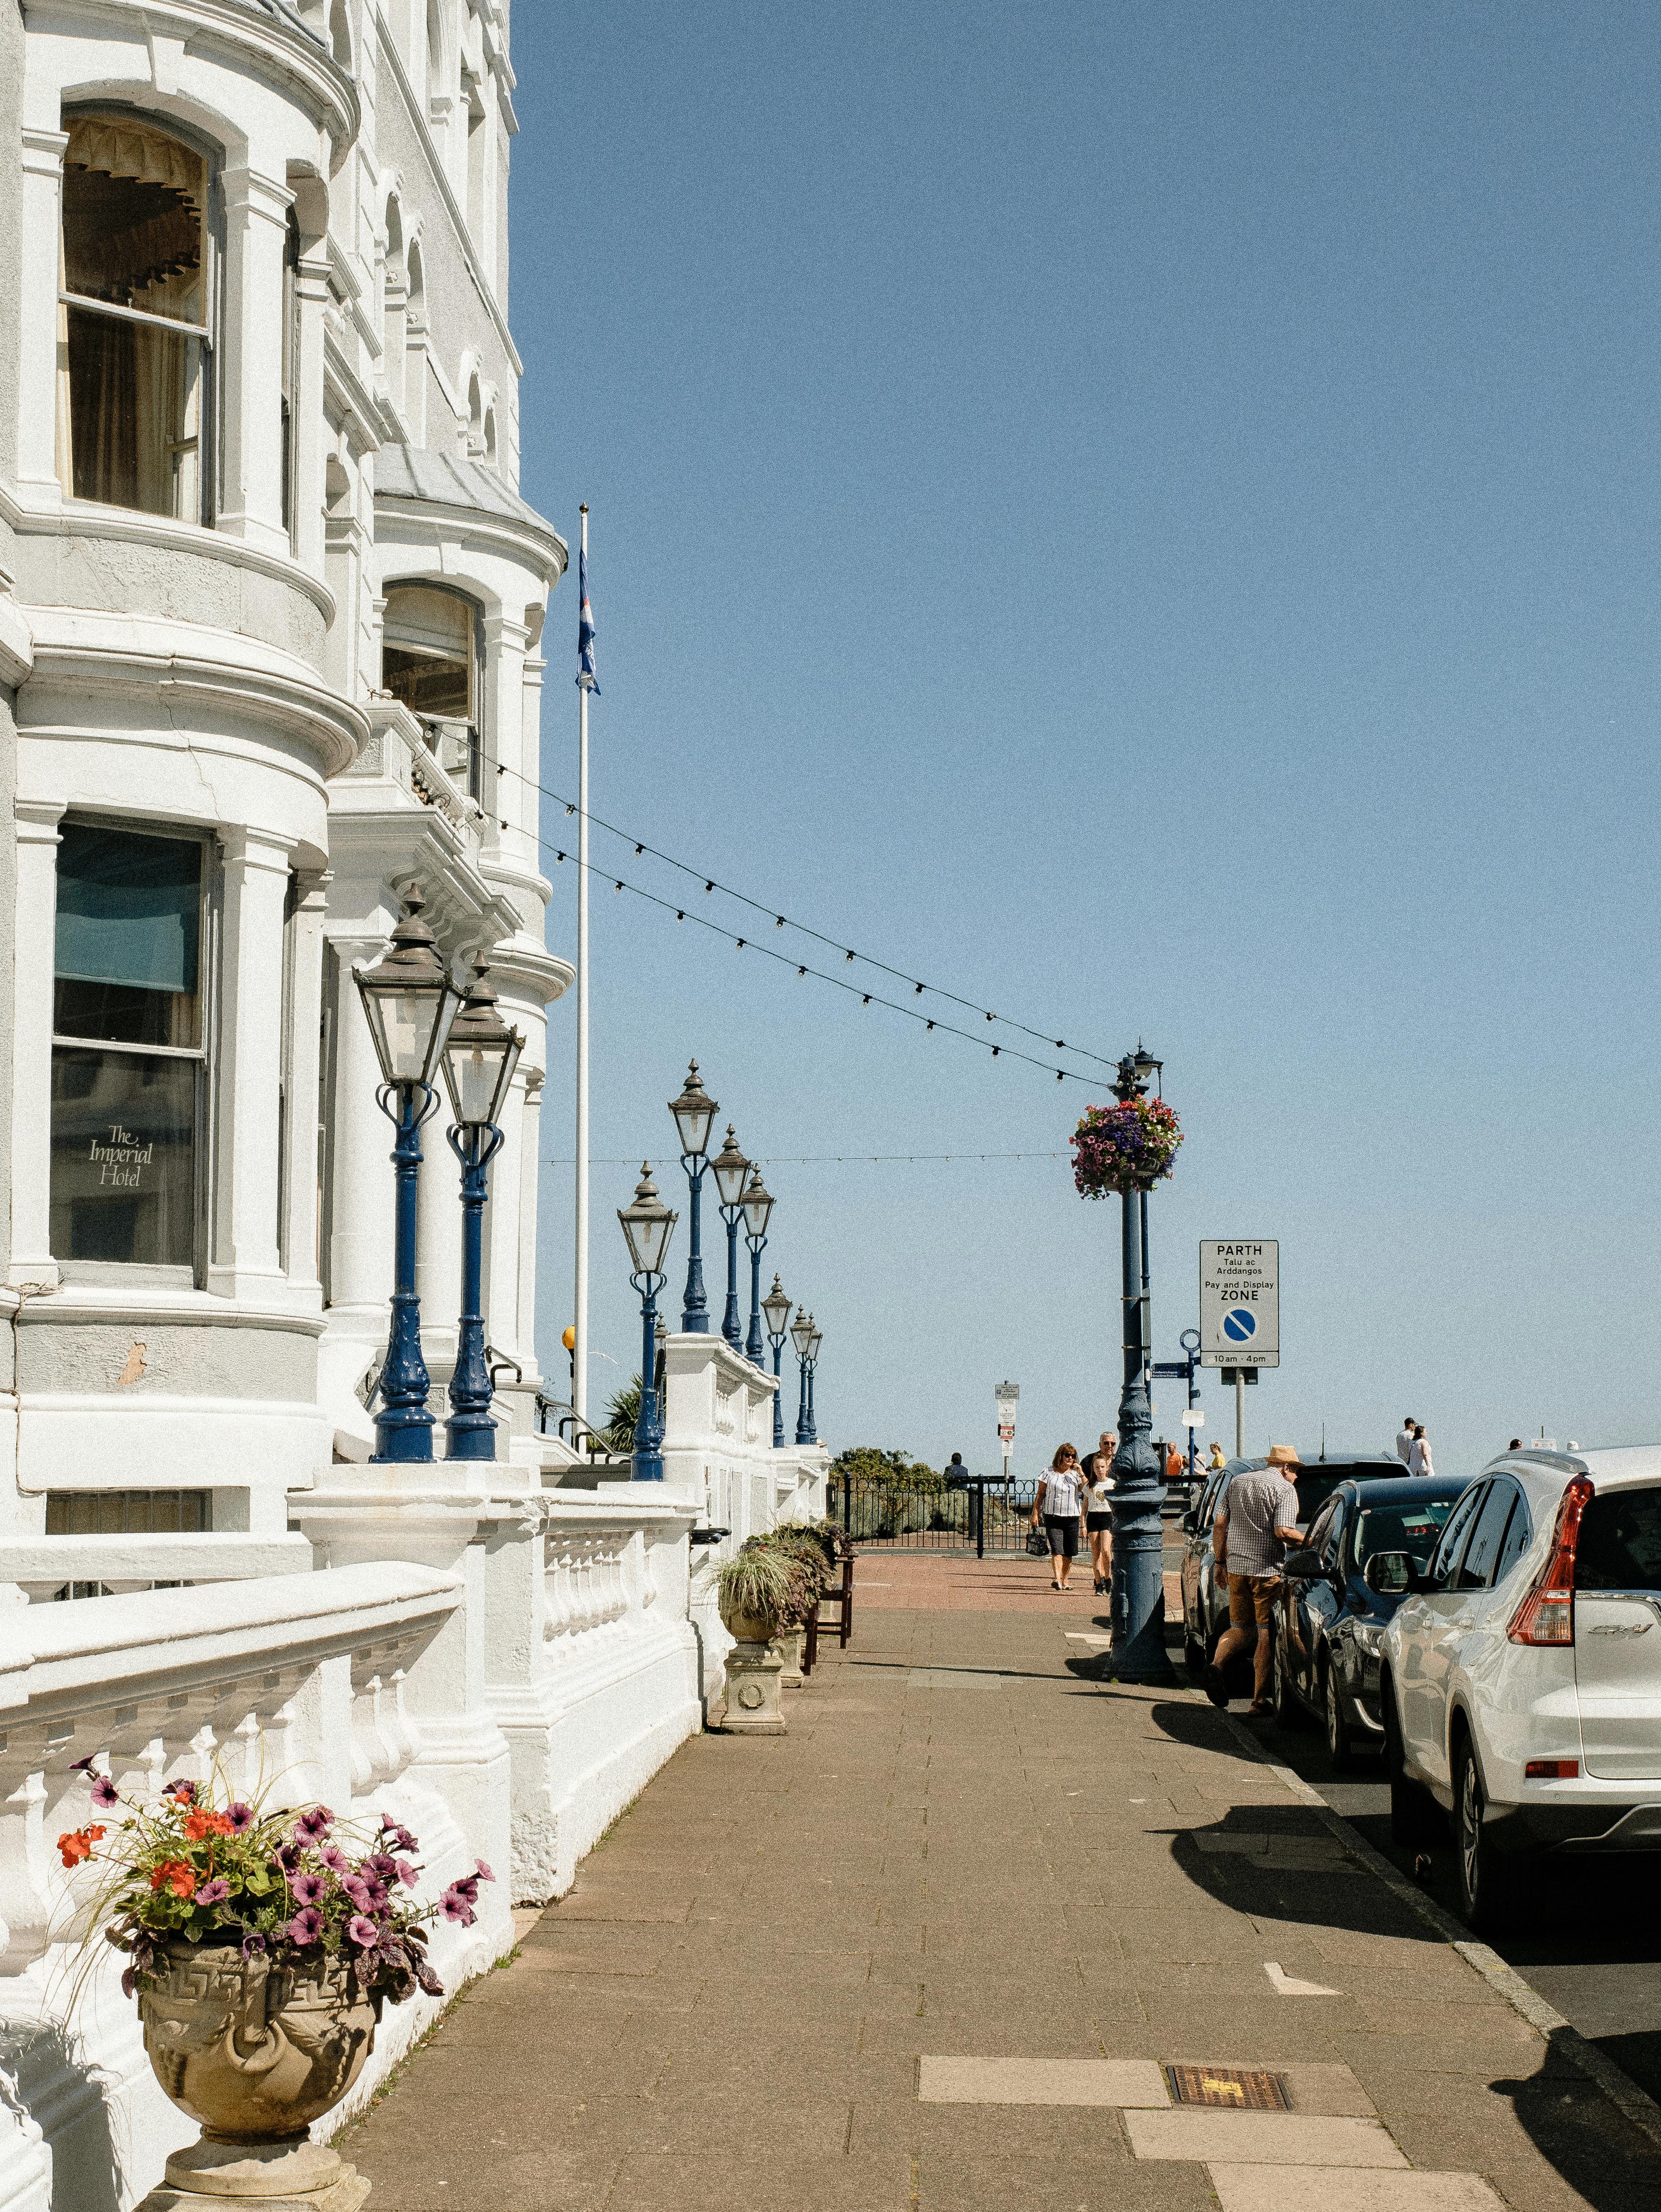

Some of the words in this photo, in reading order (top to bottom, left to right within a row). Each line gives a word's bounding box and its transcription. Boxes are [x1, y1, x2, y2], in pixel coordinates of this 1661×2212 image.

[109, 1125, 138, 1145] The
[89, 1139, 153, 1166] Imperial
[99, 1164, 141, 1187] Hotel
[1217, 1245, 1262, 1255] PARTH
[1221, 1290, 1259, 1300] ZONE
[1246, 1355, 1266, 1363] 4pm
